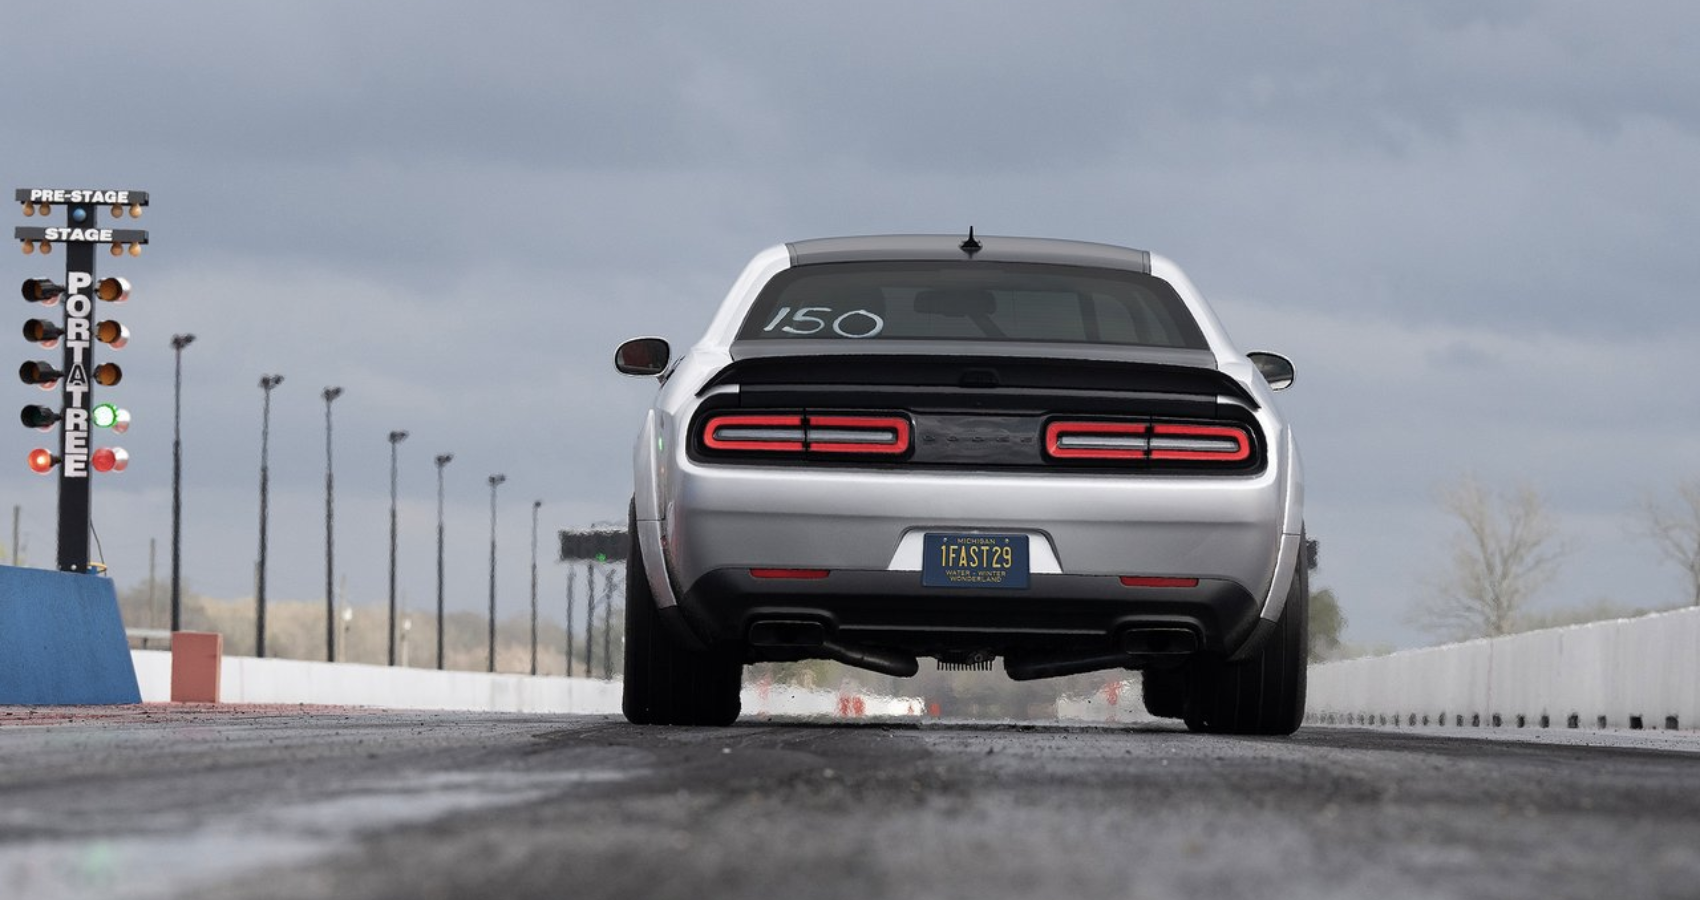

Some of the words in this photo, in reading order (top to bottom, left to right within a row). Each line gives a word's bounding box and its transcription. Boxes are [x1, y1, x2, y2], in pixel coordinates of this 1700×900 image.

[30, 189, 129, 203] PRE-STAGE
[44, 228, 113, 241] STAGE
[763, 307, 884, 338] 150
[941, 545, 1012, 568] 1FAST29
